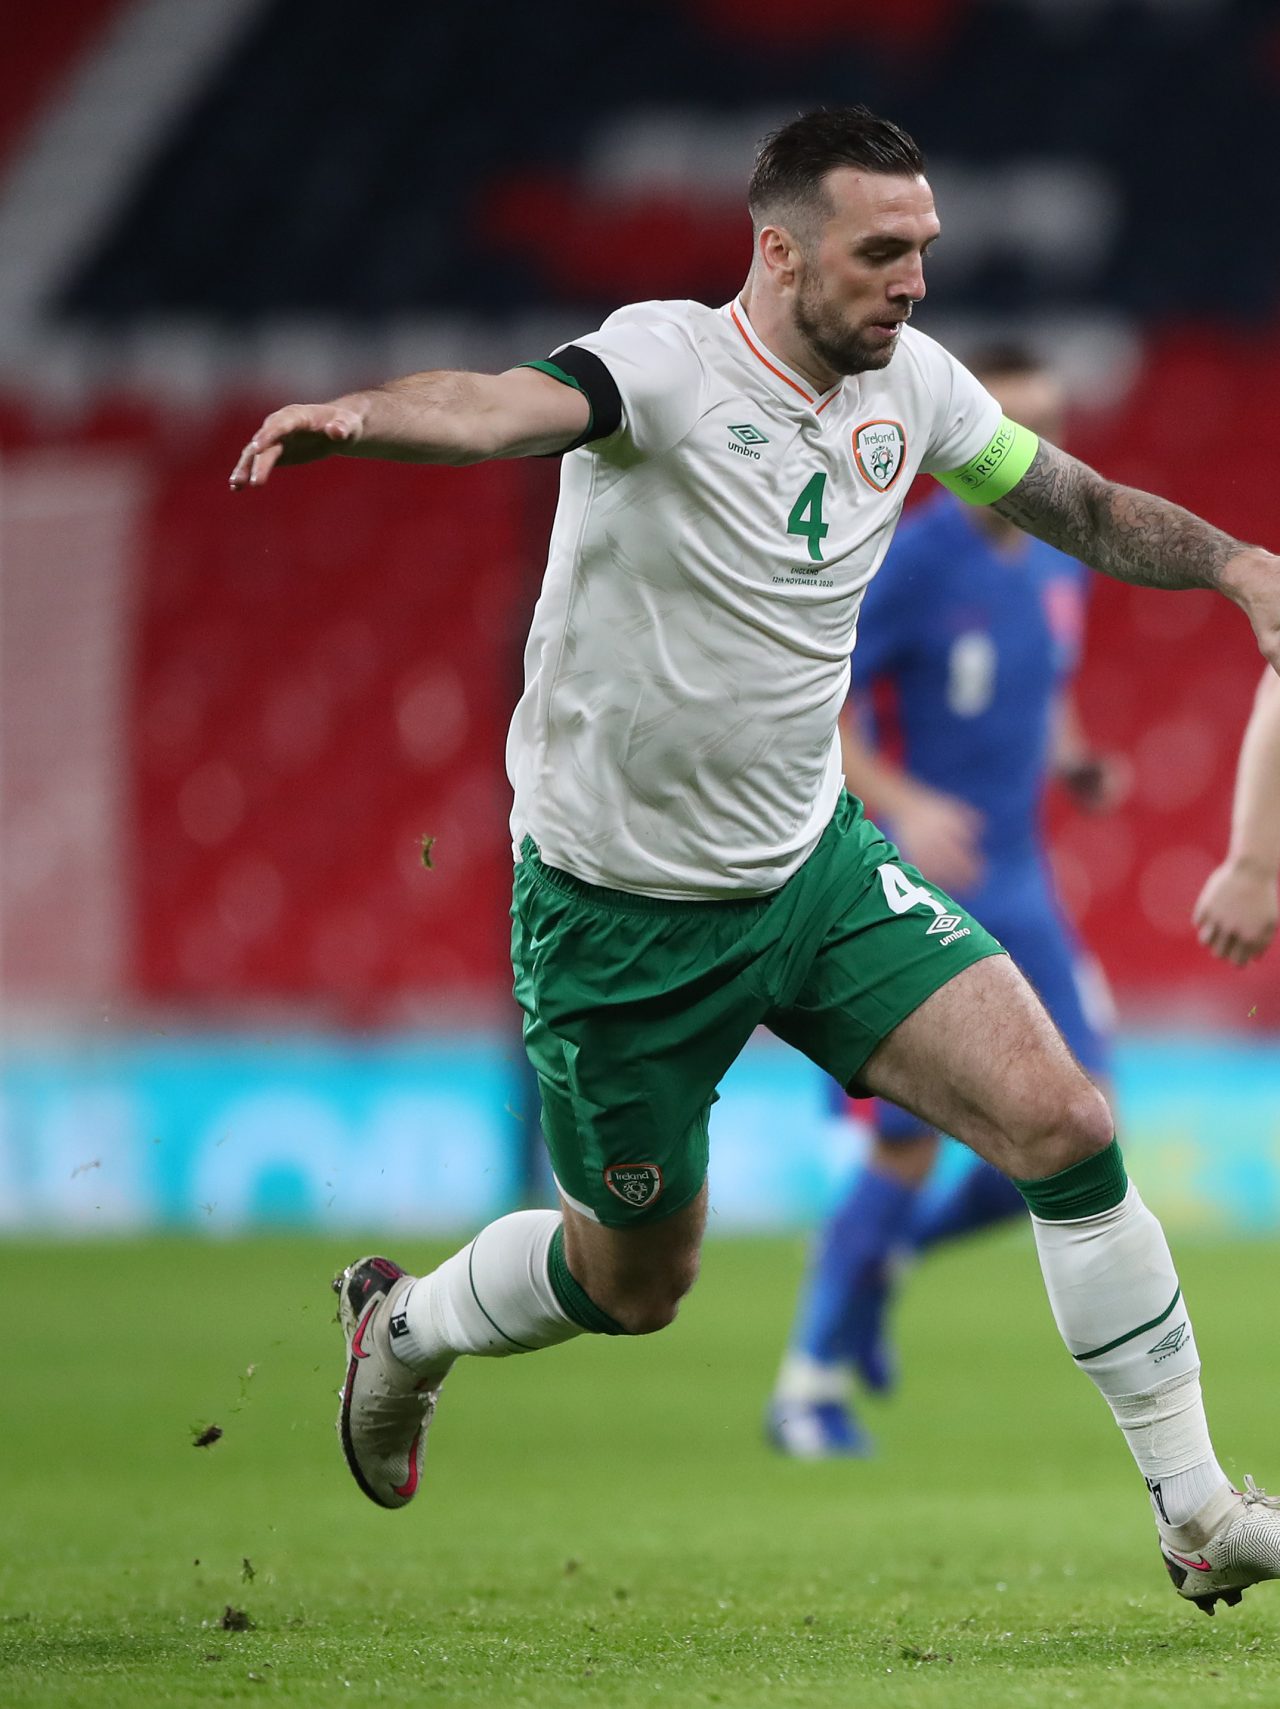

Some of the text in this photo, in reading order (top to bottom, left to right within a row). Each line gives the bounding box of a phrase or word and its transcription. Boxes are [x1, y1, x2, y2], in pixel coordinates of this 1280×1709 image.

[862, 431, 895, 446] Ireland
[728, 441, 761, 460] umbro
[976, 422, 1014, 476] RESPEC
[787, 472, 829, 561] 4
[791, 568, 819, 576] ENGLAND
[785, 578, 817, 587] NOVEMBER
[819, 579, 834, 588] 2020
[877, 863, 948, 915] 4
[940, 927, 971, 946] umbro
[615, 1171, 649, 1180] Ireland
